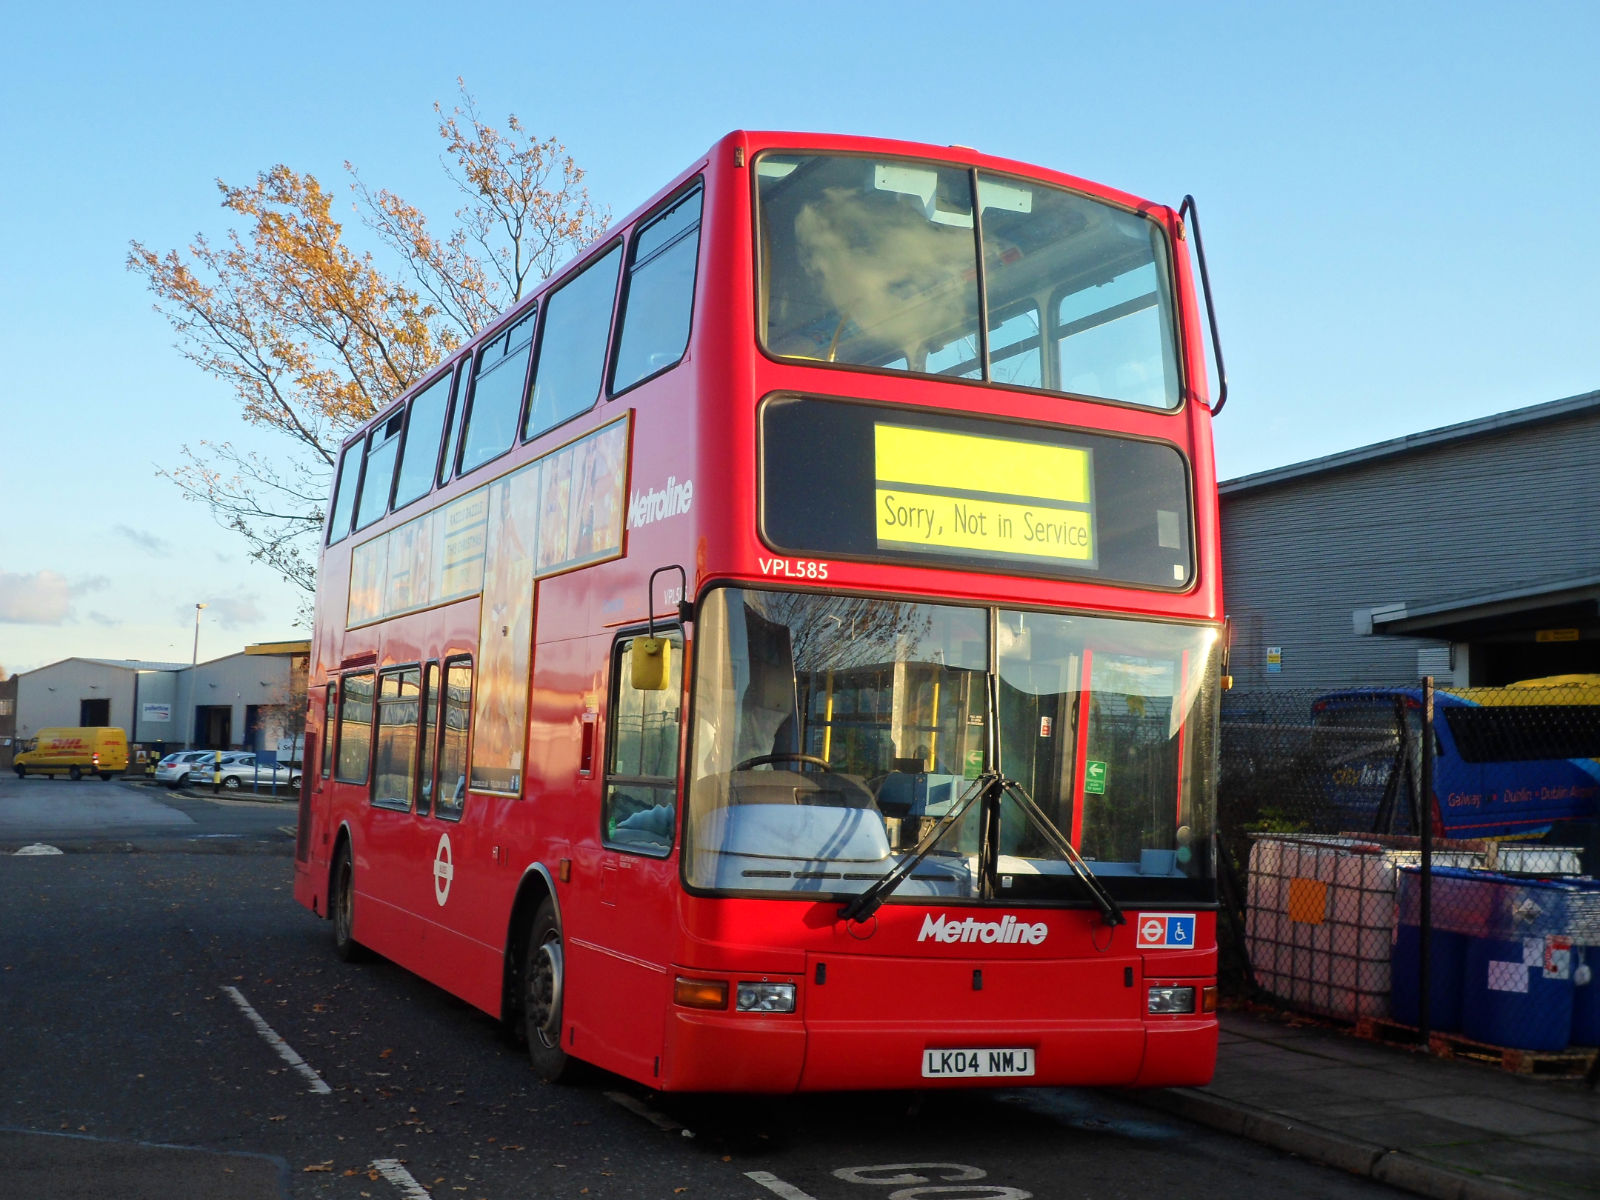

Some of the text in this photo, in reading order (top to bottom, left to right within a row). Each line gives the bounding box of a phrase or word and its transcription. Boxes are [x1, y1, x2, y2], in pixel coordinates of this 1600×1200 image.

[626, 475, 693, 530] Metroline
[884, 495, 1088, 548] Sorry, Not in Service
[758, 557, 829, 580] VPL585
[1503, 787, 1532, 803] Dublin
[916, 912, 1049, 945] Metroline
[928, 1051, 1028, 1074] LK04 NMJ
